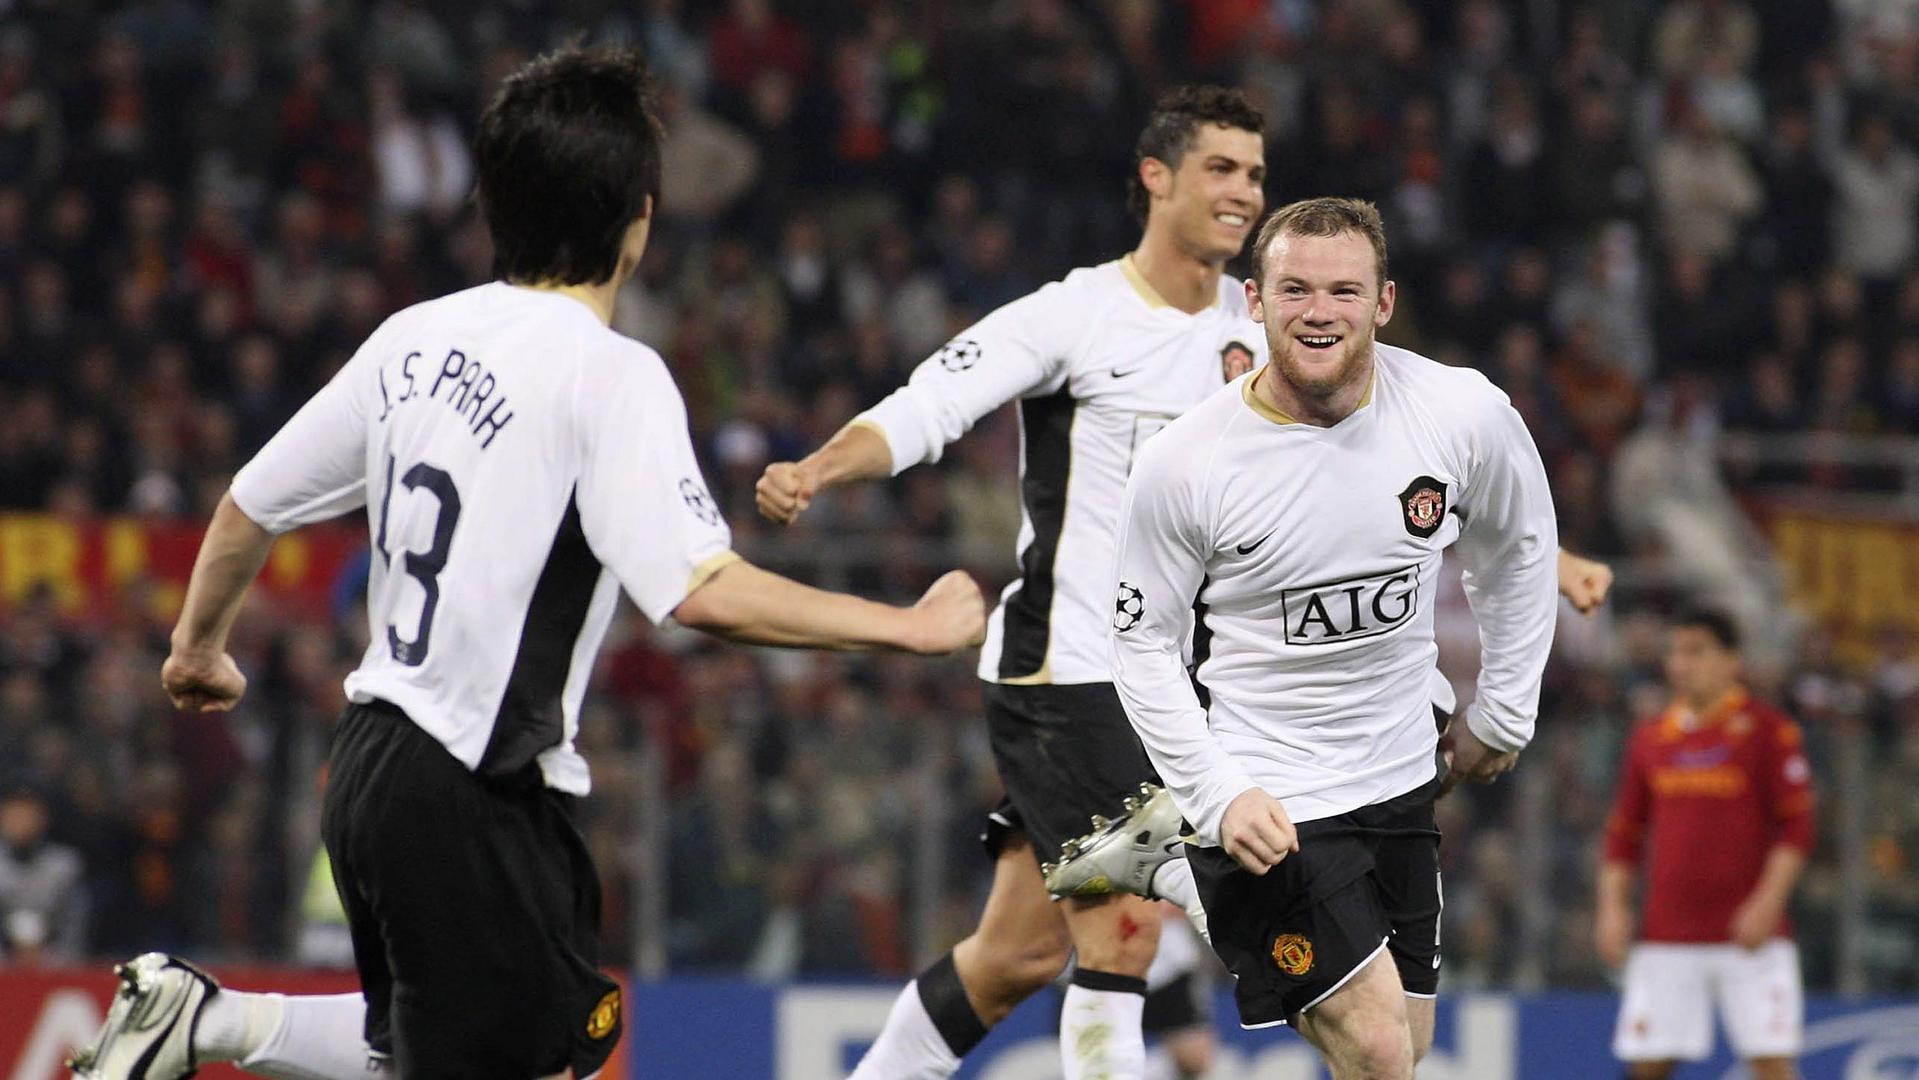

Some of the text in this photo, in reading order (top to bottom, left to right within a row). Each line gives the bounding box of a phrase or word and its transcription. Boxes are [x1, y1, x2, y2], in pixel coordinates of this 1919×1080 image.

[379, 348, 513, 450] J. S. PARK
[1293, 573, 1413, 637] AIG
